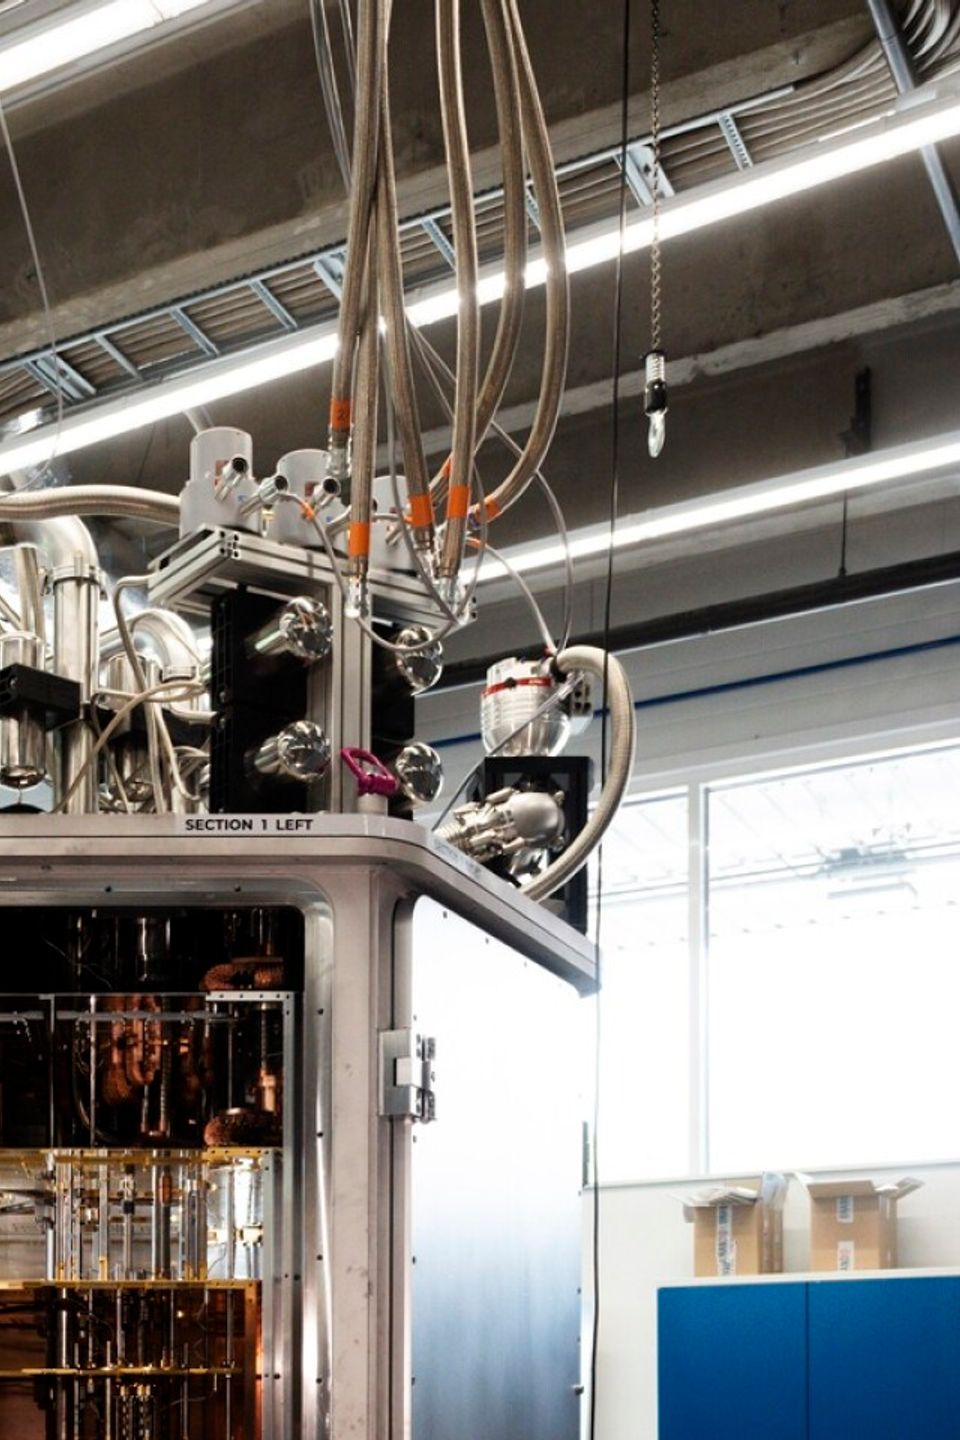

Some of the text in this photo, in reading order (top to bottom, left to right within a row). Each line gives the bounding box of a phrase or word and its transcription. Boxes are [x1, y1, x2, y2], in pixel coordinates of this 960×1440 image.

[185, 818, 313, 831] SECTION 1 LEFT
